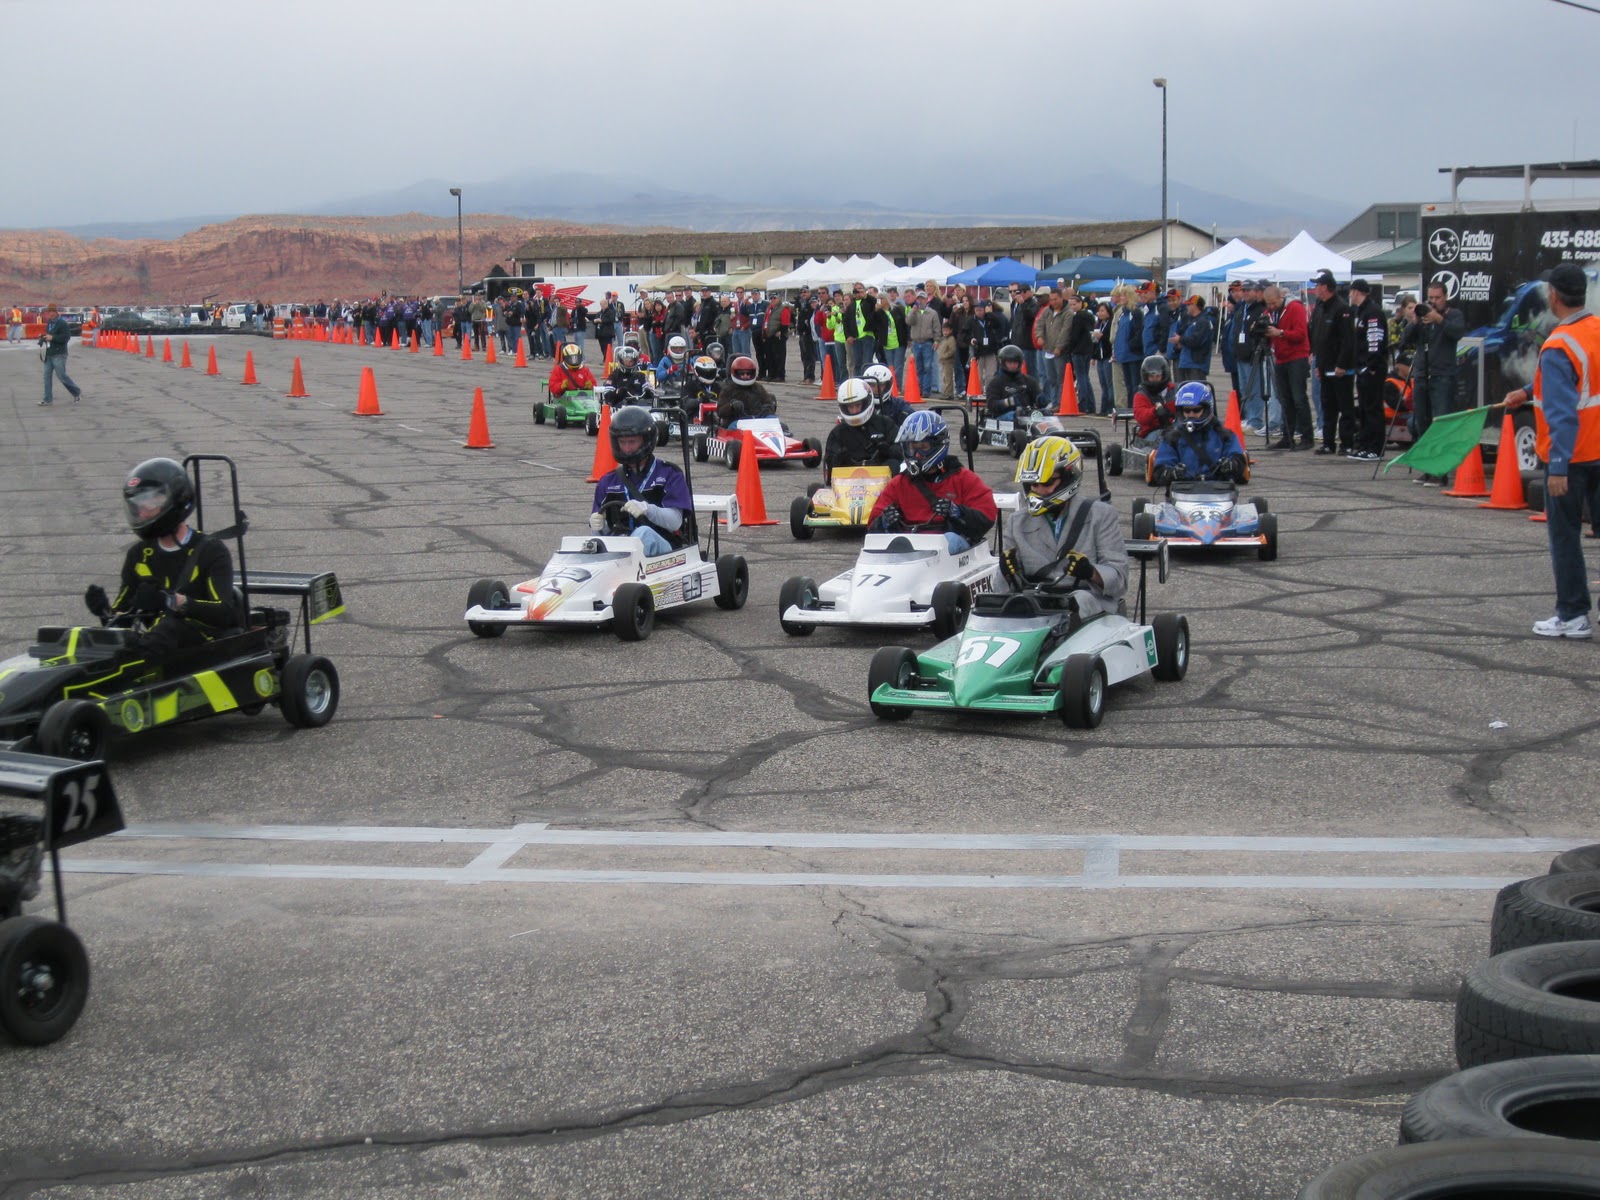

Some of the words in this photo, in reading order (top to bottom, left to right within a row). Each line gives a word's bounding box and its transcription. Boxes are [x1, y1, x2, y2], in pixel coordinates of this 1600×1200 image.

[1461, 230, 1494, 248] Findlay
[1540, 230, 1600, 248] 435-688
[1459, 252, 1493, 262] SUBARU
[1561, 250, 1573, 260] St.
[1461, 272, 1492, 290] Findlay
[1459, 291, 1490, 301] HYUNDAI
[857, 573, 892, 588] 77
[955, 635, 1022, 669] 57
[62, 773, 100, 833] 25
